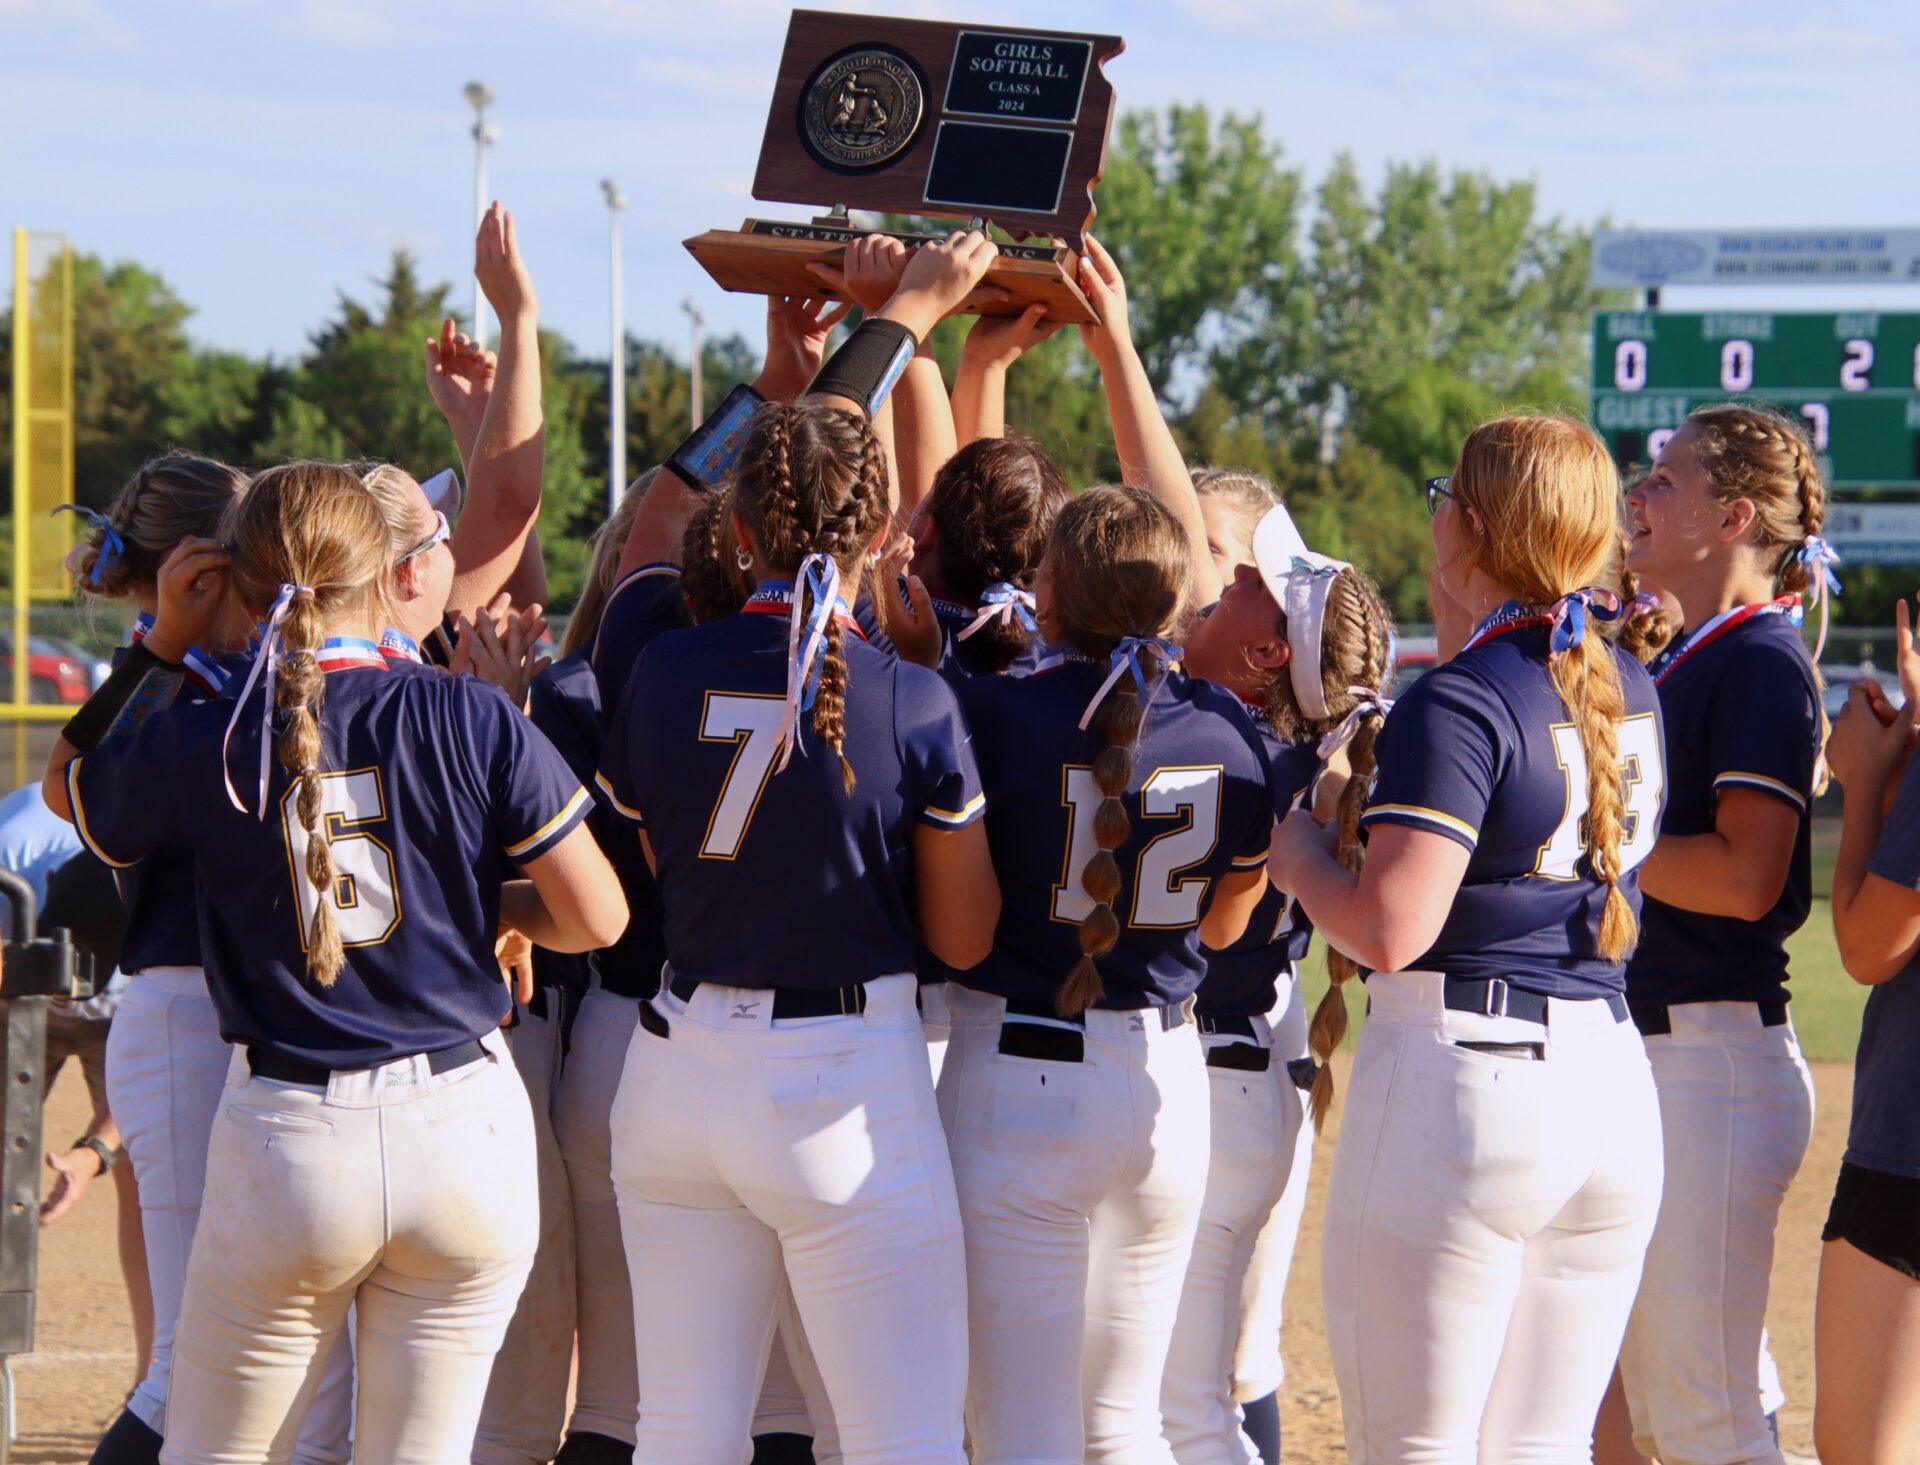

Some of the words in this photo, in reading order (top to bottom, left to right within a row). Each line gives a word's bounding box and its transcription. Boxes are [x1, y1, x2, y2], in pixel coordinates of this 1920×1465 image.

[969, 56, 1069, 78] SOFTBALL
[994, 42, 1052, 60] GIRLS
[988, 81, 1031, 94] CLASS
[1032, 85, 1041, 95] A
[998, 99, 1025, 111] 2024
[1615, 340, 1647, 392] 0
[1721, 340, 1754, 392] 0
[1840, 340, 1874, 392] 2
[698, 690, 789, 861] 7
[1528, 712, 1667, 882] 13
[280, 766, 403, 953] 6
[1050, 764, 1224, 929] 12
